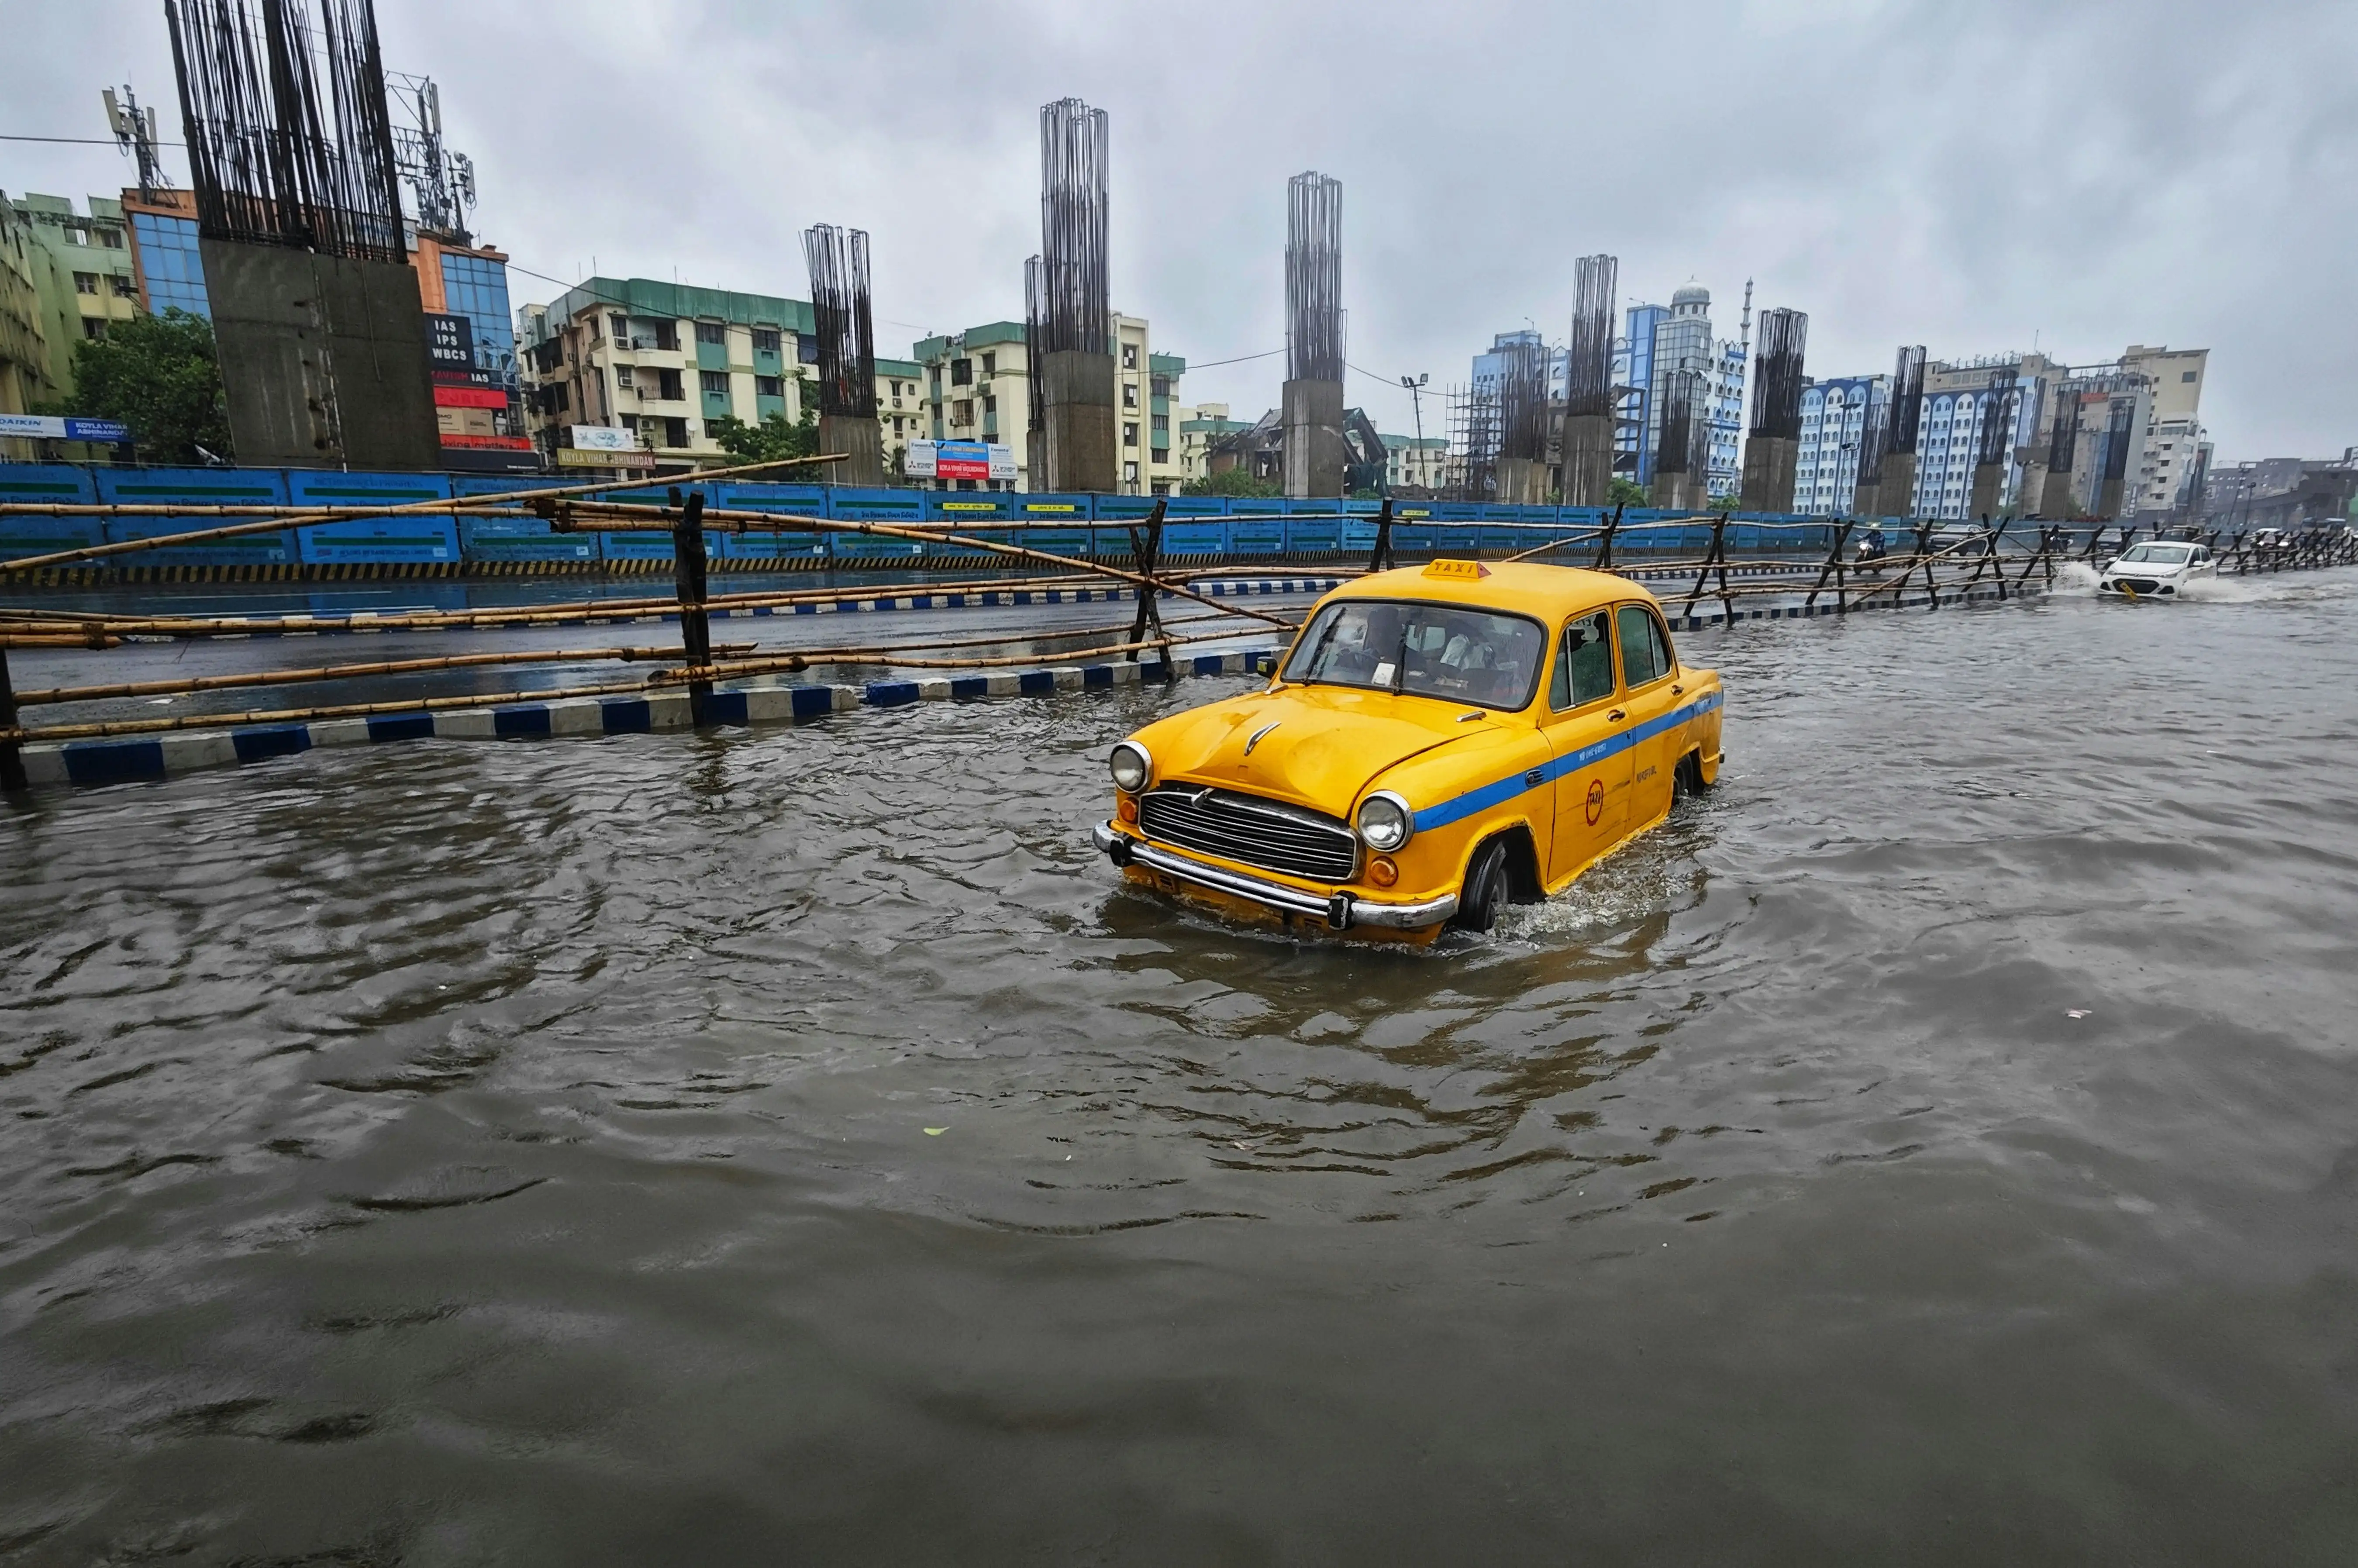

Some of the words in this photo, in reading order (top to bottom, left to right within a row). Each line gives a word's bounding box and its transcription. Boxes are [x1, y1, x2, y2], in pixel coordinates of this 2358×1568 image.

[434, 320, 456, 332] IAS
[437, 334, 457, 346] IPS
[432, 348, 466, 360] WBCS
[471, 373, 489, 383] IAS
[562, 451, 584, 463] KOYLA
[586, 453, 608, 464] VIHAR
[610, 455, 653, 466] ABHINANDAN
[1435, 562, 1473, 573] TAXI
